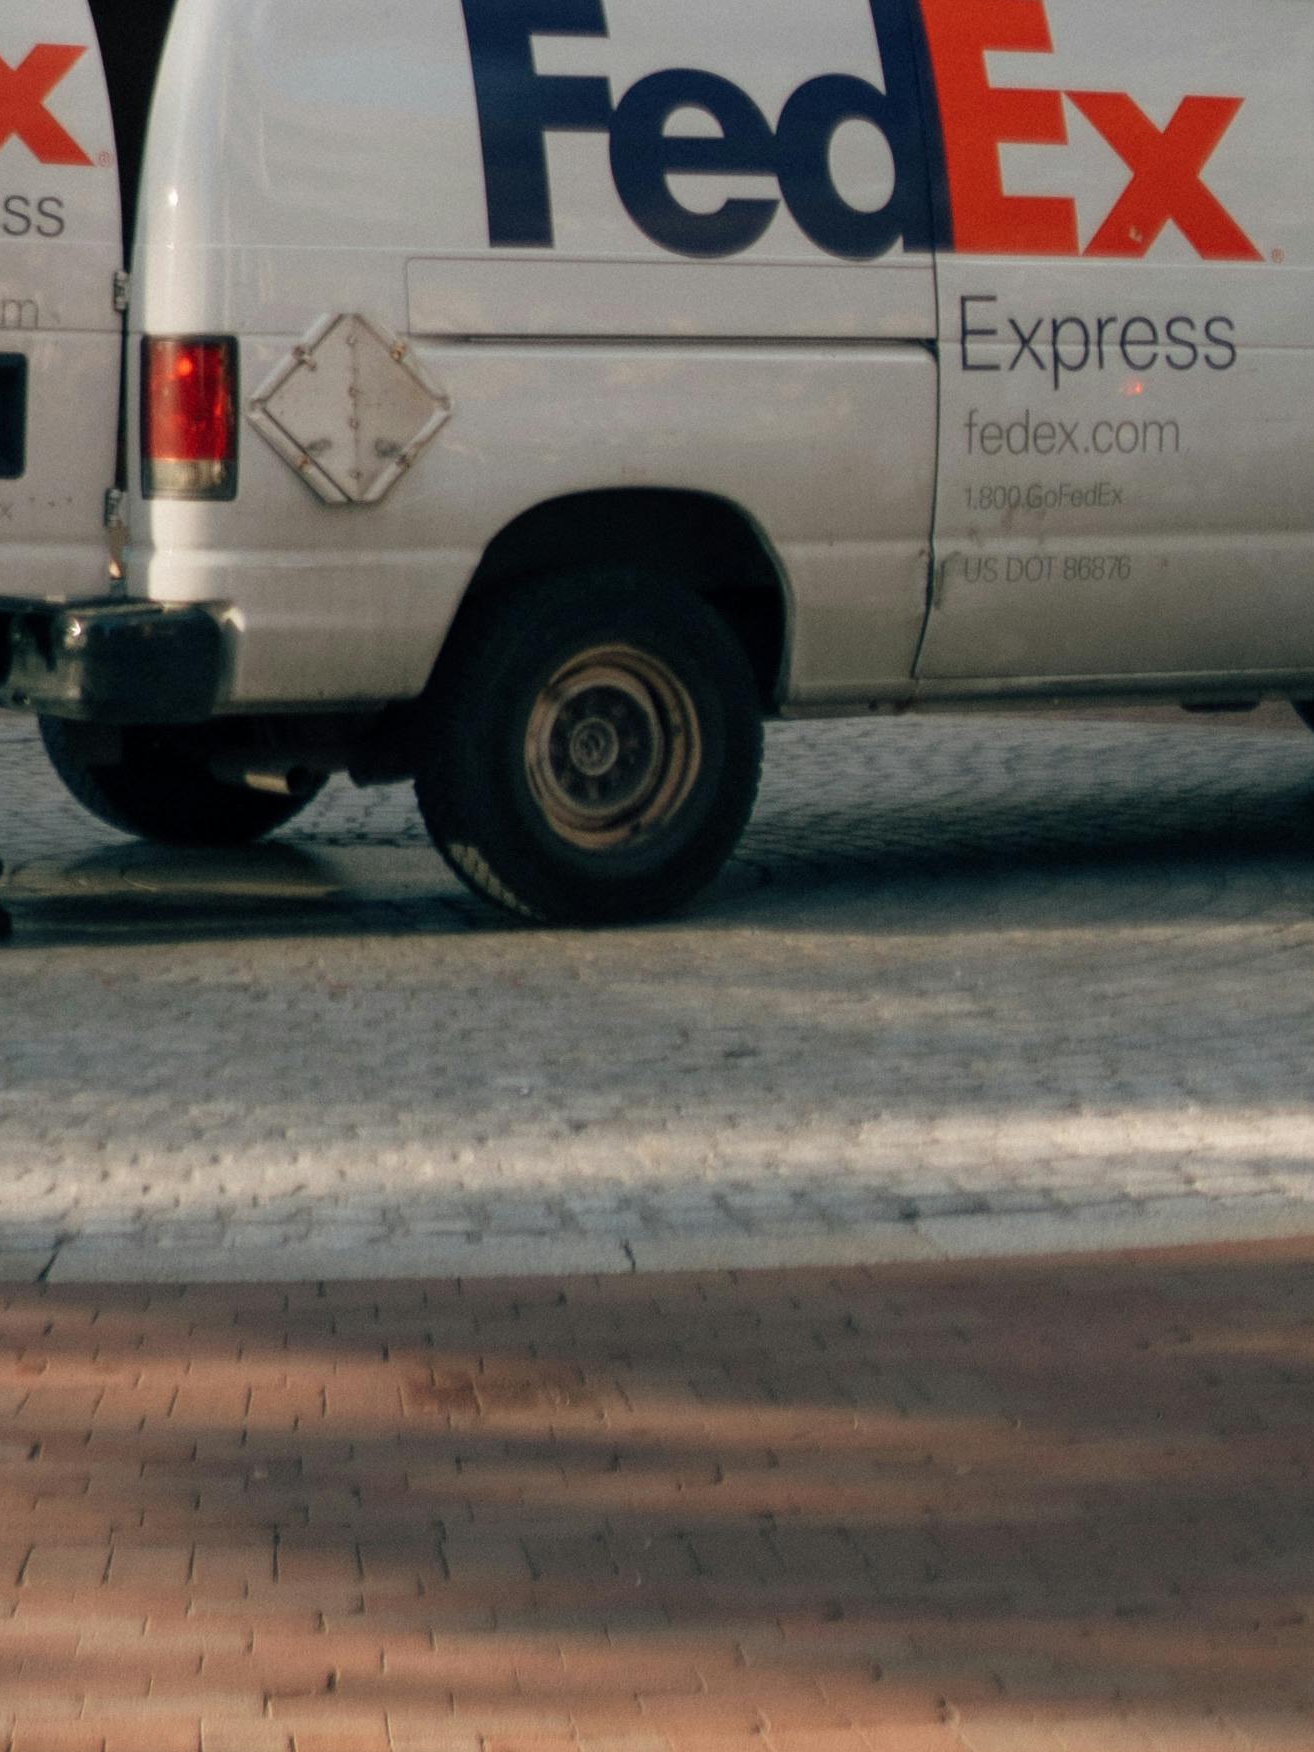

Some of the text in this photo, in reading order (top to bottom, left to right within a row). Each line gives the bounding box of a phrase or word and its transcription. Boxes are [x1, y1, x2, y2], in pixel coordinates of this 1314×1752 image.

[959, 296, 1237, 390] Express
[964, 408, 1180, 456] fedex.com
[965, 481, 1124, 511] 1.800.GoFedEx
[964, 554, 1132, 584] US DOT 86876
